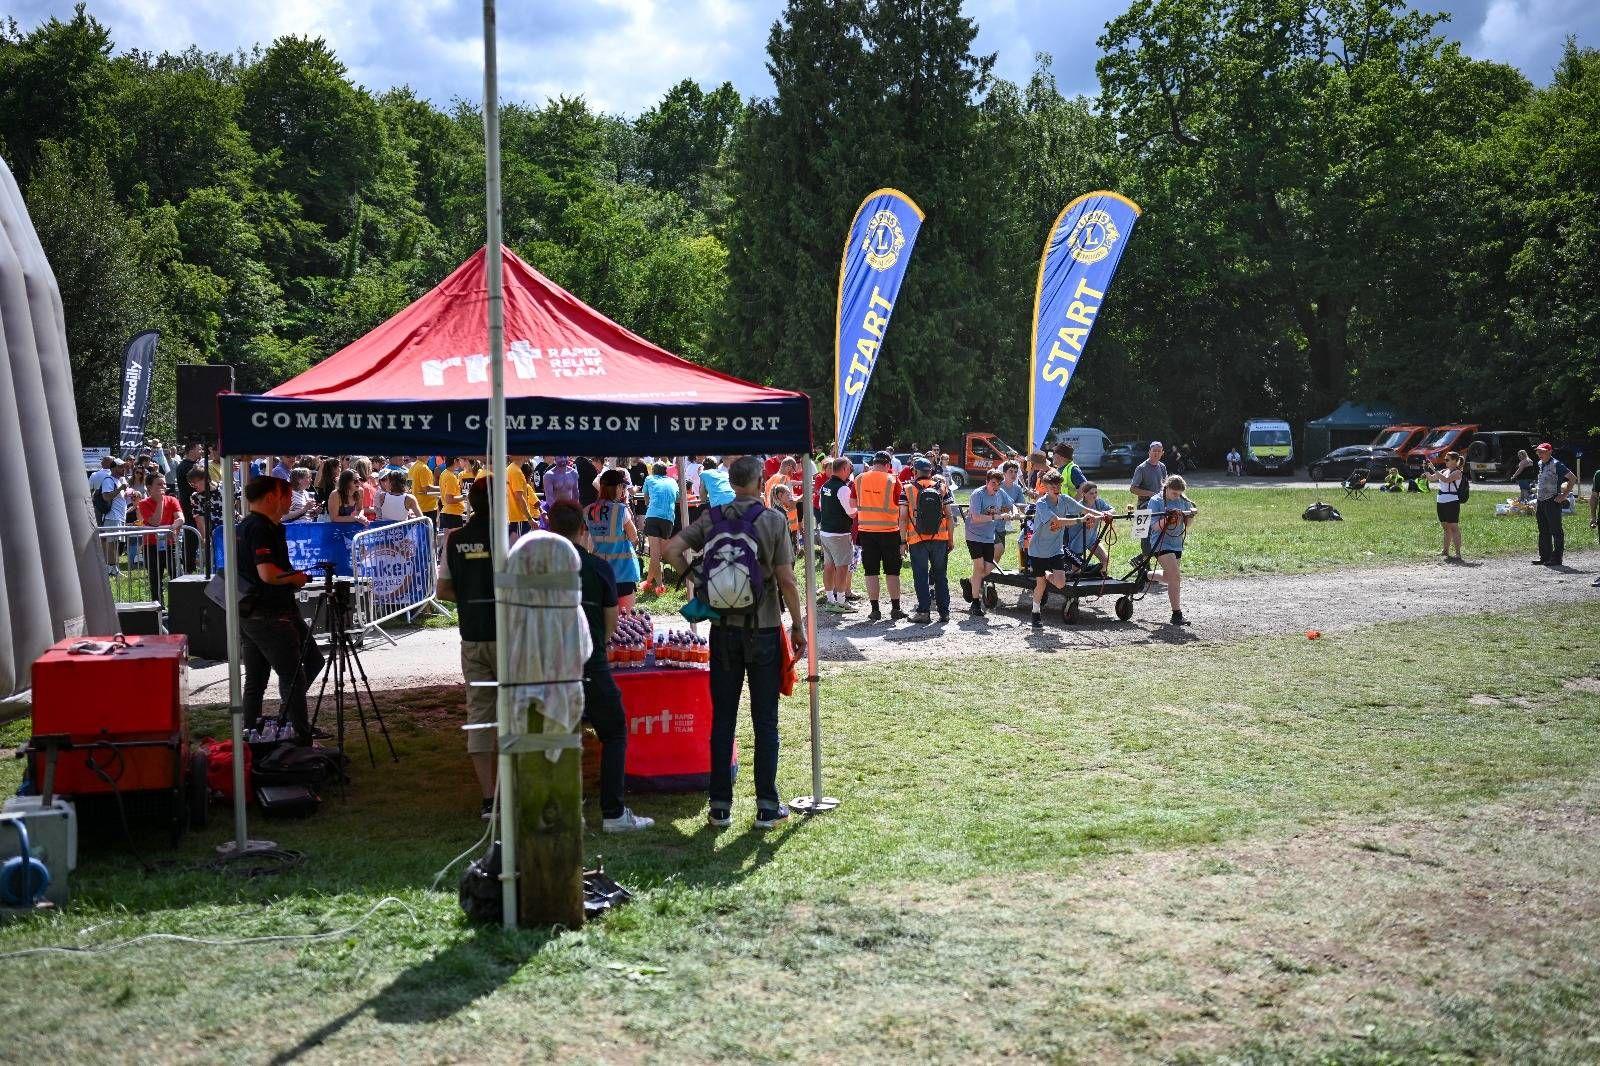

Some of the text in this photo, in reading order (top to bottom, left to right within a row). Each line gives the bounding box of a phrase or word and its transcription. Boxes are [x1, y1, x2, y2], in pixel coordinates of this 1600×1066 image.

[876, 229, 889, 250] L
[1085, 227, 1099, 246] L
[844, 285, 893, 397] START
[1042, 277, 1105, 388] START
[547, 347, 601, 358] RAPID
[549, 357, 603, 368] RELIEF
[552, 367, 608, 378] TEAM
[122, 360, 143, 418] Piccadilly
[251, 412, 434, 430] COMMUNITY
[669, 416, 782, 432] SUPPORT
[1136, 514, 1150, 526] 67
[456, 543, 485, 553] YOUR
[630, 709, 673, 735] rrt
